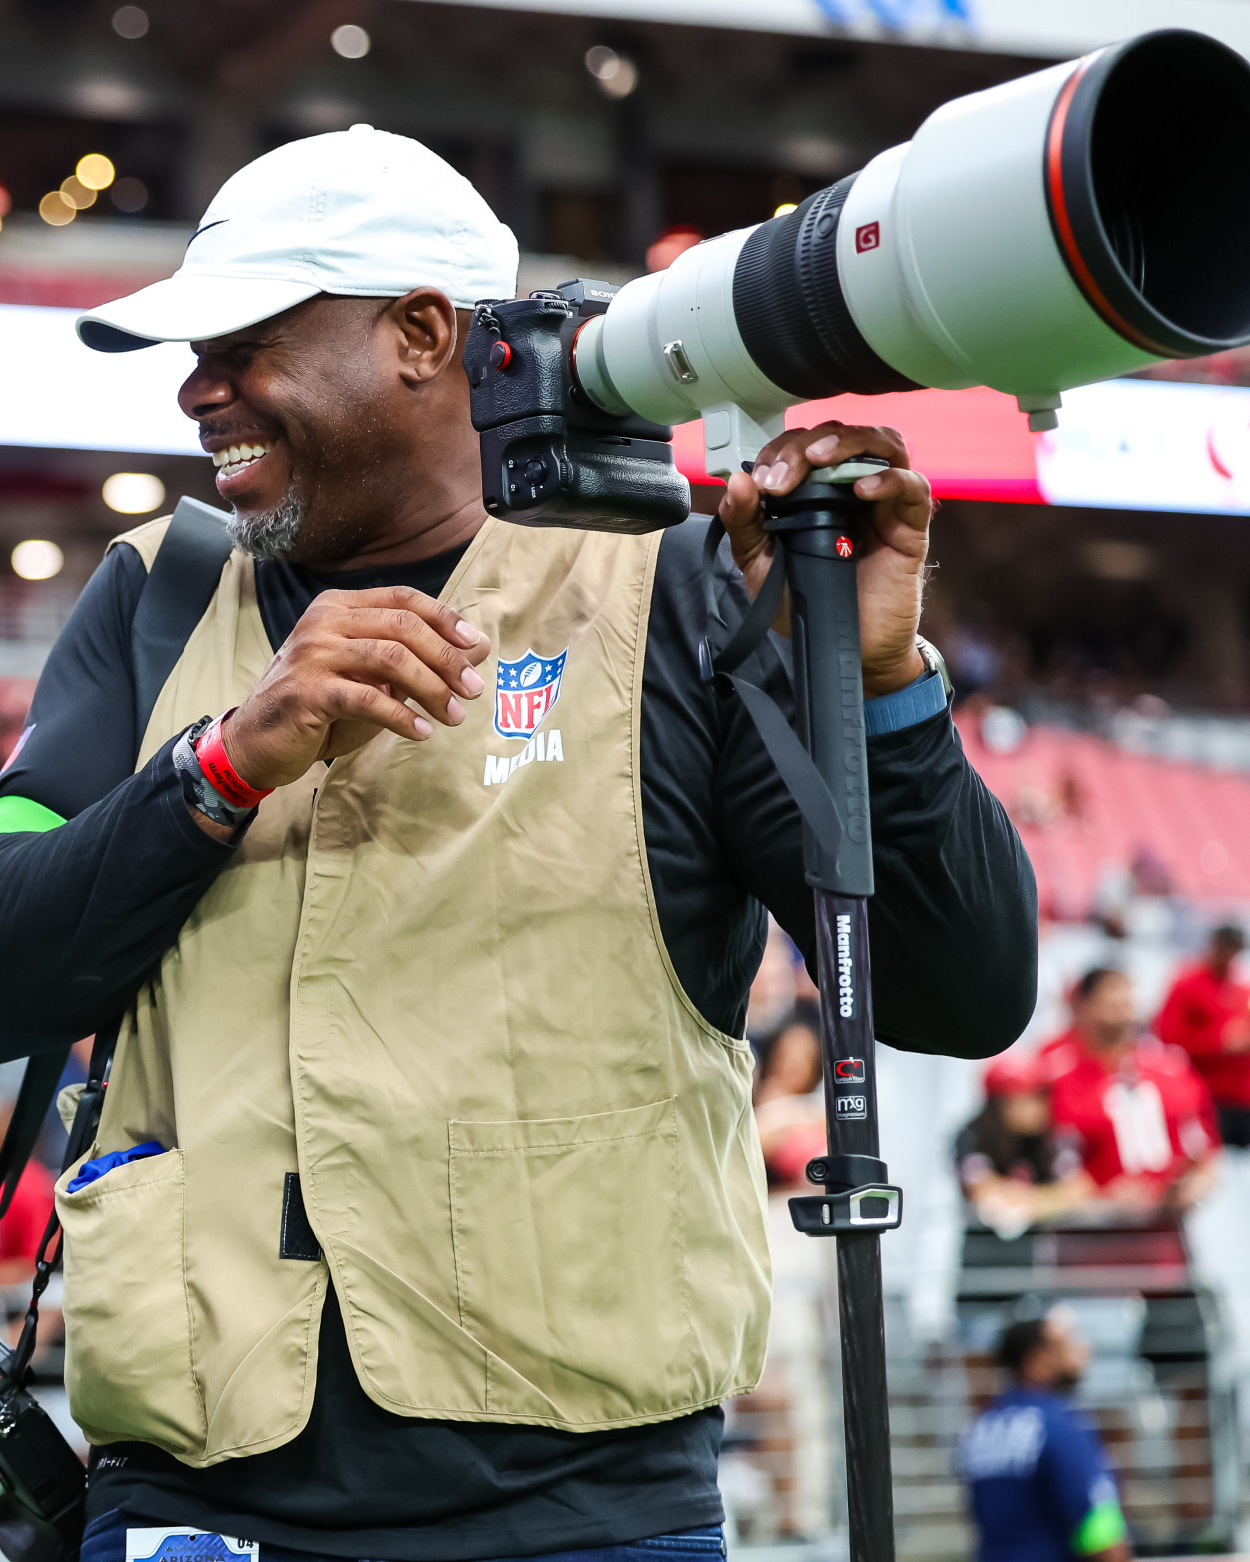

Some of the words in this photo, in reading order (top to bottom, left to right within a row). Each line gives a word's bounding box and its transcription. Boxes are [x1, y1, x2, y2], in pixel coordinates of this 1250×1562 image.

[590, 289, 616, 299] SON
[499, 683, 554, 729] NFL
[836, 914, 854, 1018] Manfrotto
